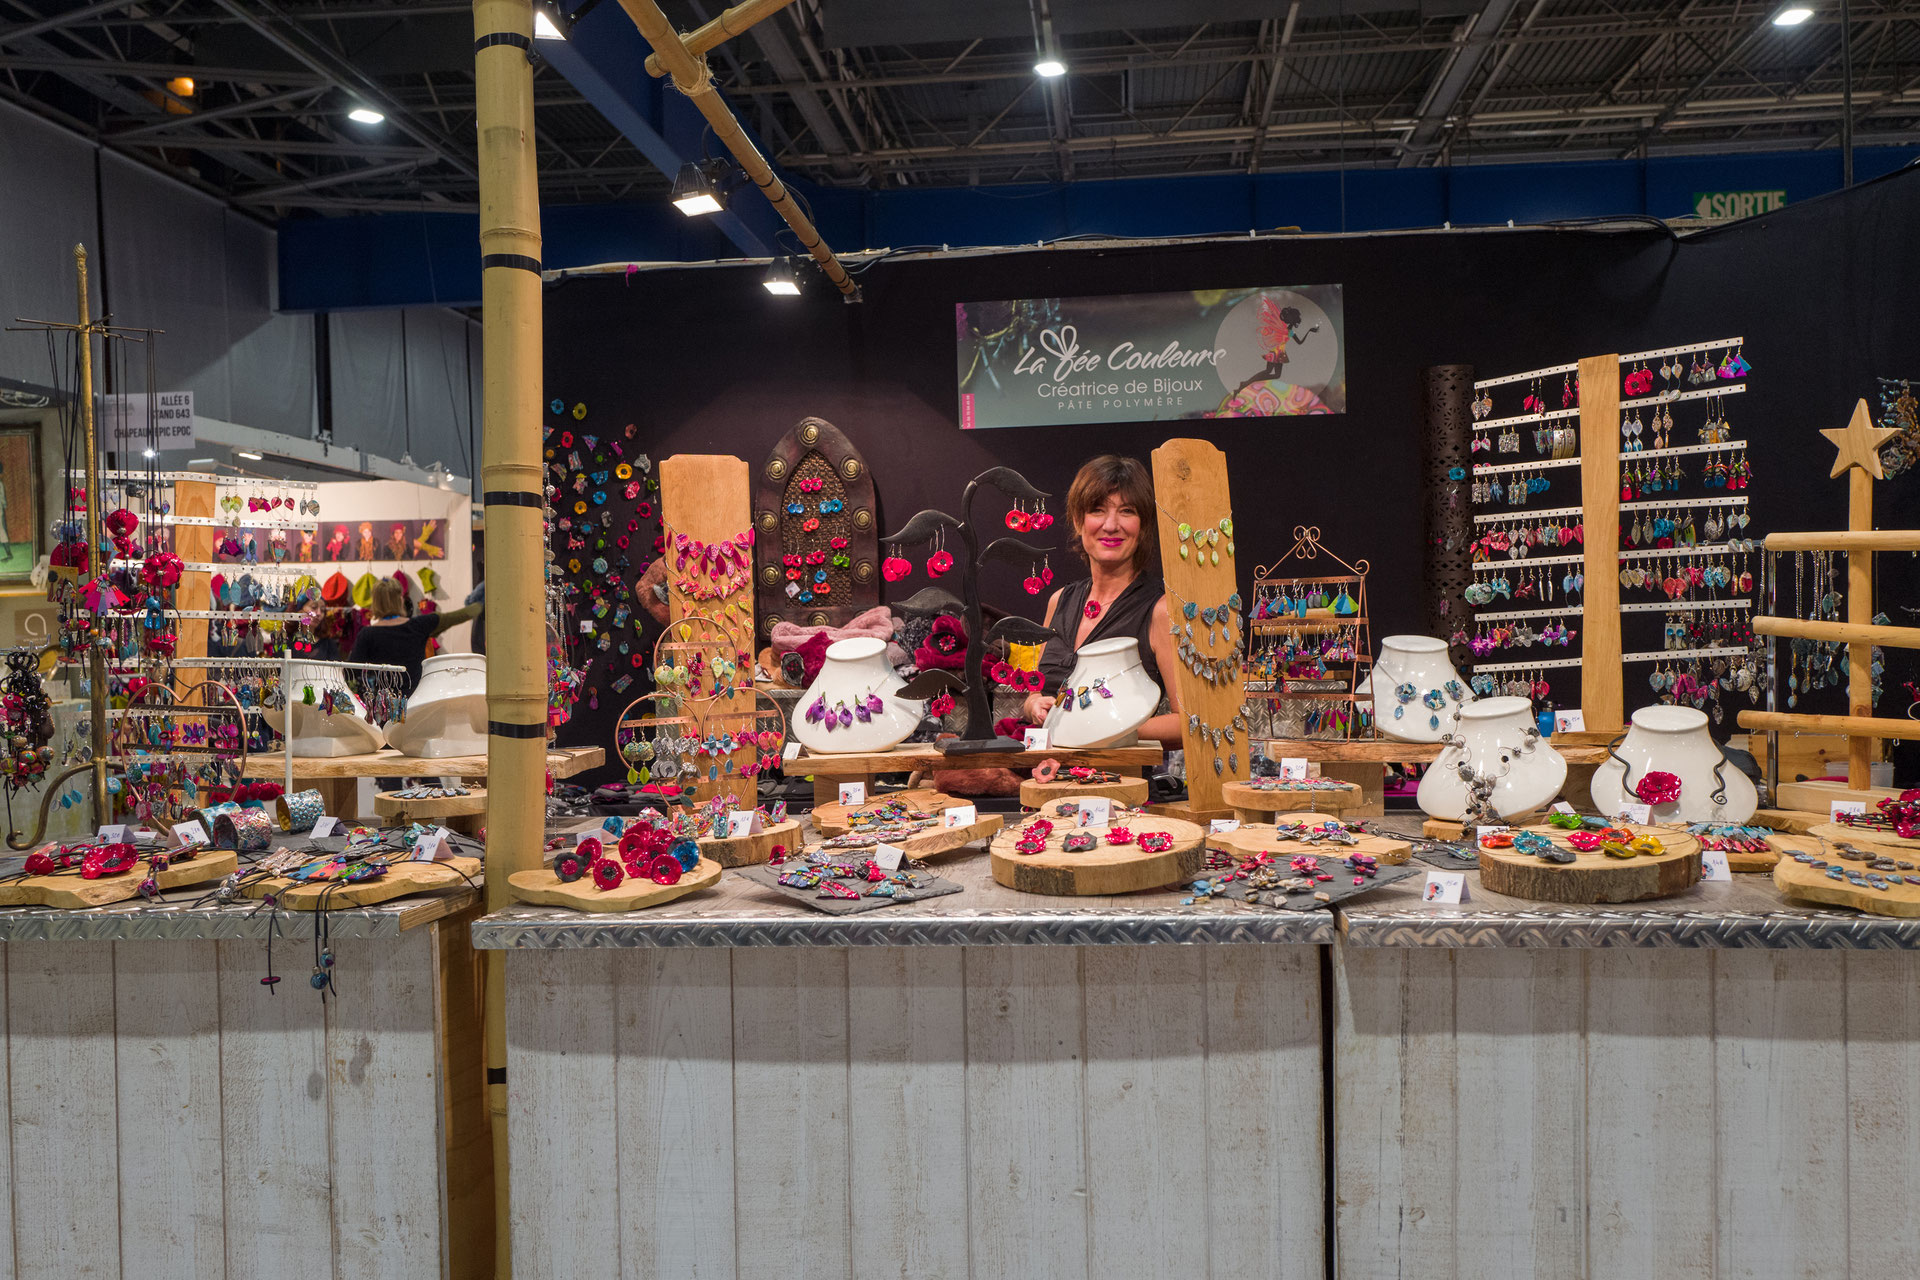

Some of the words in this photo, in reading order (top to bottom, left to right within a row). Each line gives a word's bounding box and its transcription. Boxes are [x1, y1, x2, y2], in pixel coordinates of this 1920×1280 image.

[1711, 191, 1786, 218] SORTIE
[1013, 346, 1047, 376] La
[1107, 340, 1227, 371] Couleurs
[1037, 380, 1119, 398] Créatrice
[1124, 379, 1148, 394] de
[1153, 378, 1203, 396] Bijoux
[160, 394, 183, 406] ALLÉE
[184, 395, 190, 405] 6
[1058, 399, 1093, 410] PÂTE
[1103, 396, 1184, 409] POLYMÈRE
